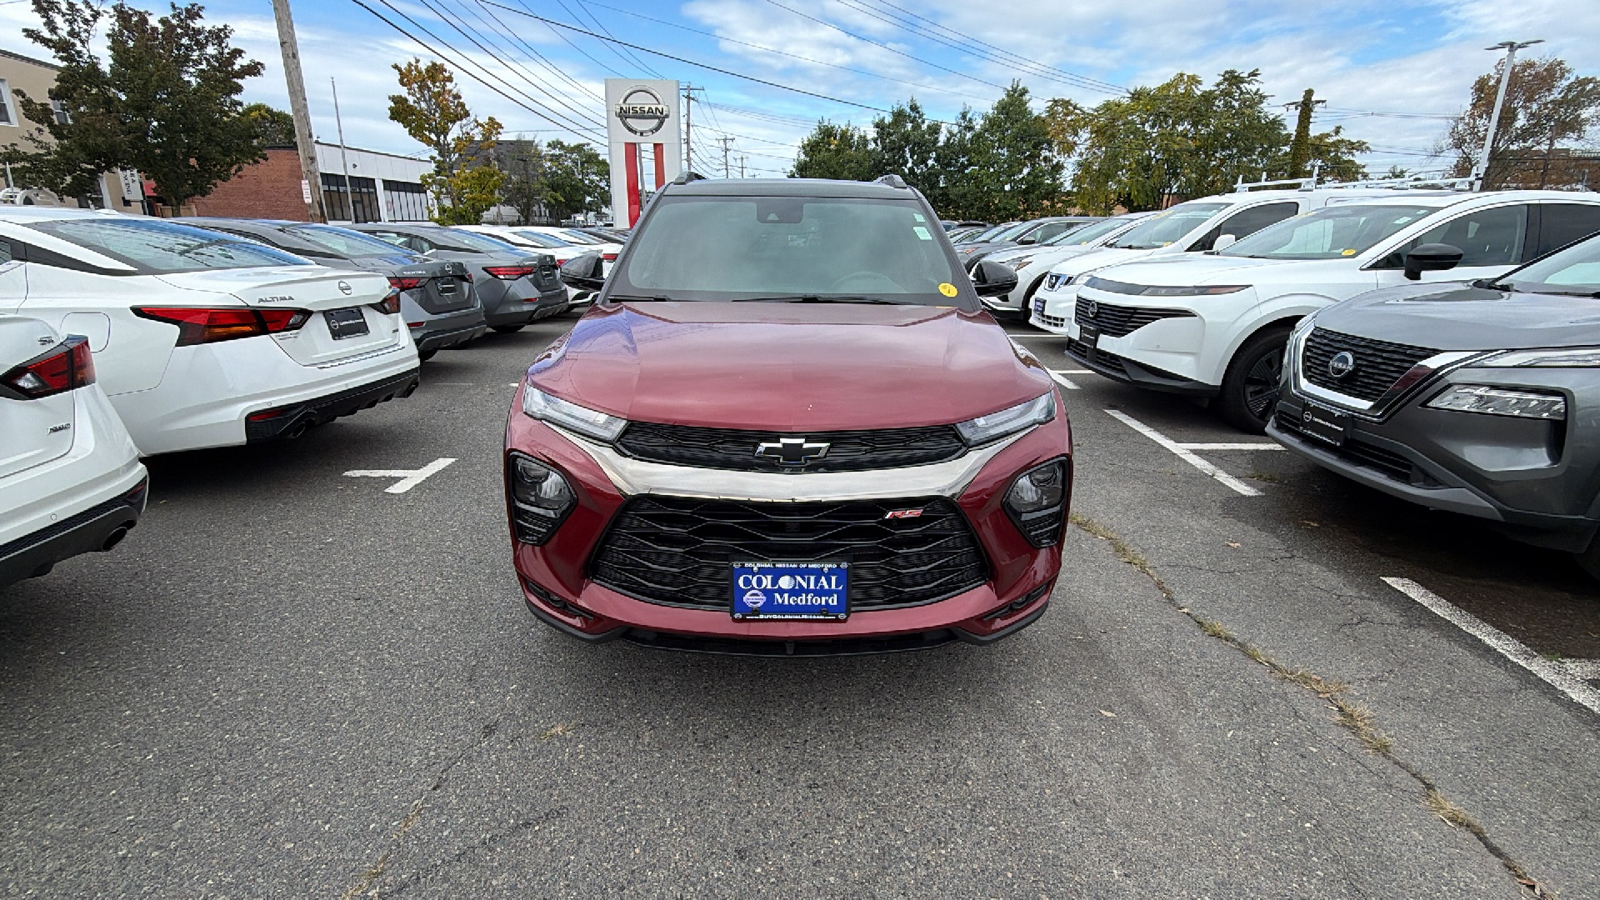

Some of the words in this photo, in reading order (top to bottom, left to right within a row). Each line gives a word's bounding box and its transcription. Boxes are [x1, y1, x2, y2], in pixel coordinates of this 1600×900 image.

[619, 106, 664, 115] NISSAN
[258, 296, 295, 304] ALTIMA
[884, 508, 924, 519] RS
[738, 575, 843, 590] COLONIAL
[773, 592, 838, 606] Medford
